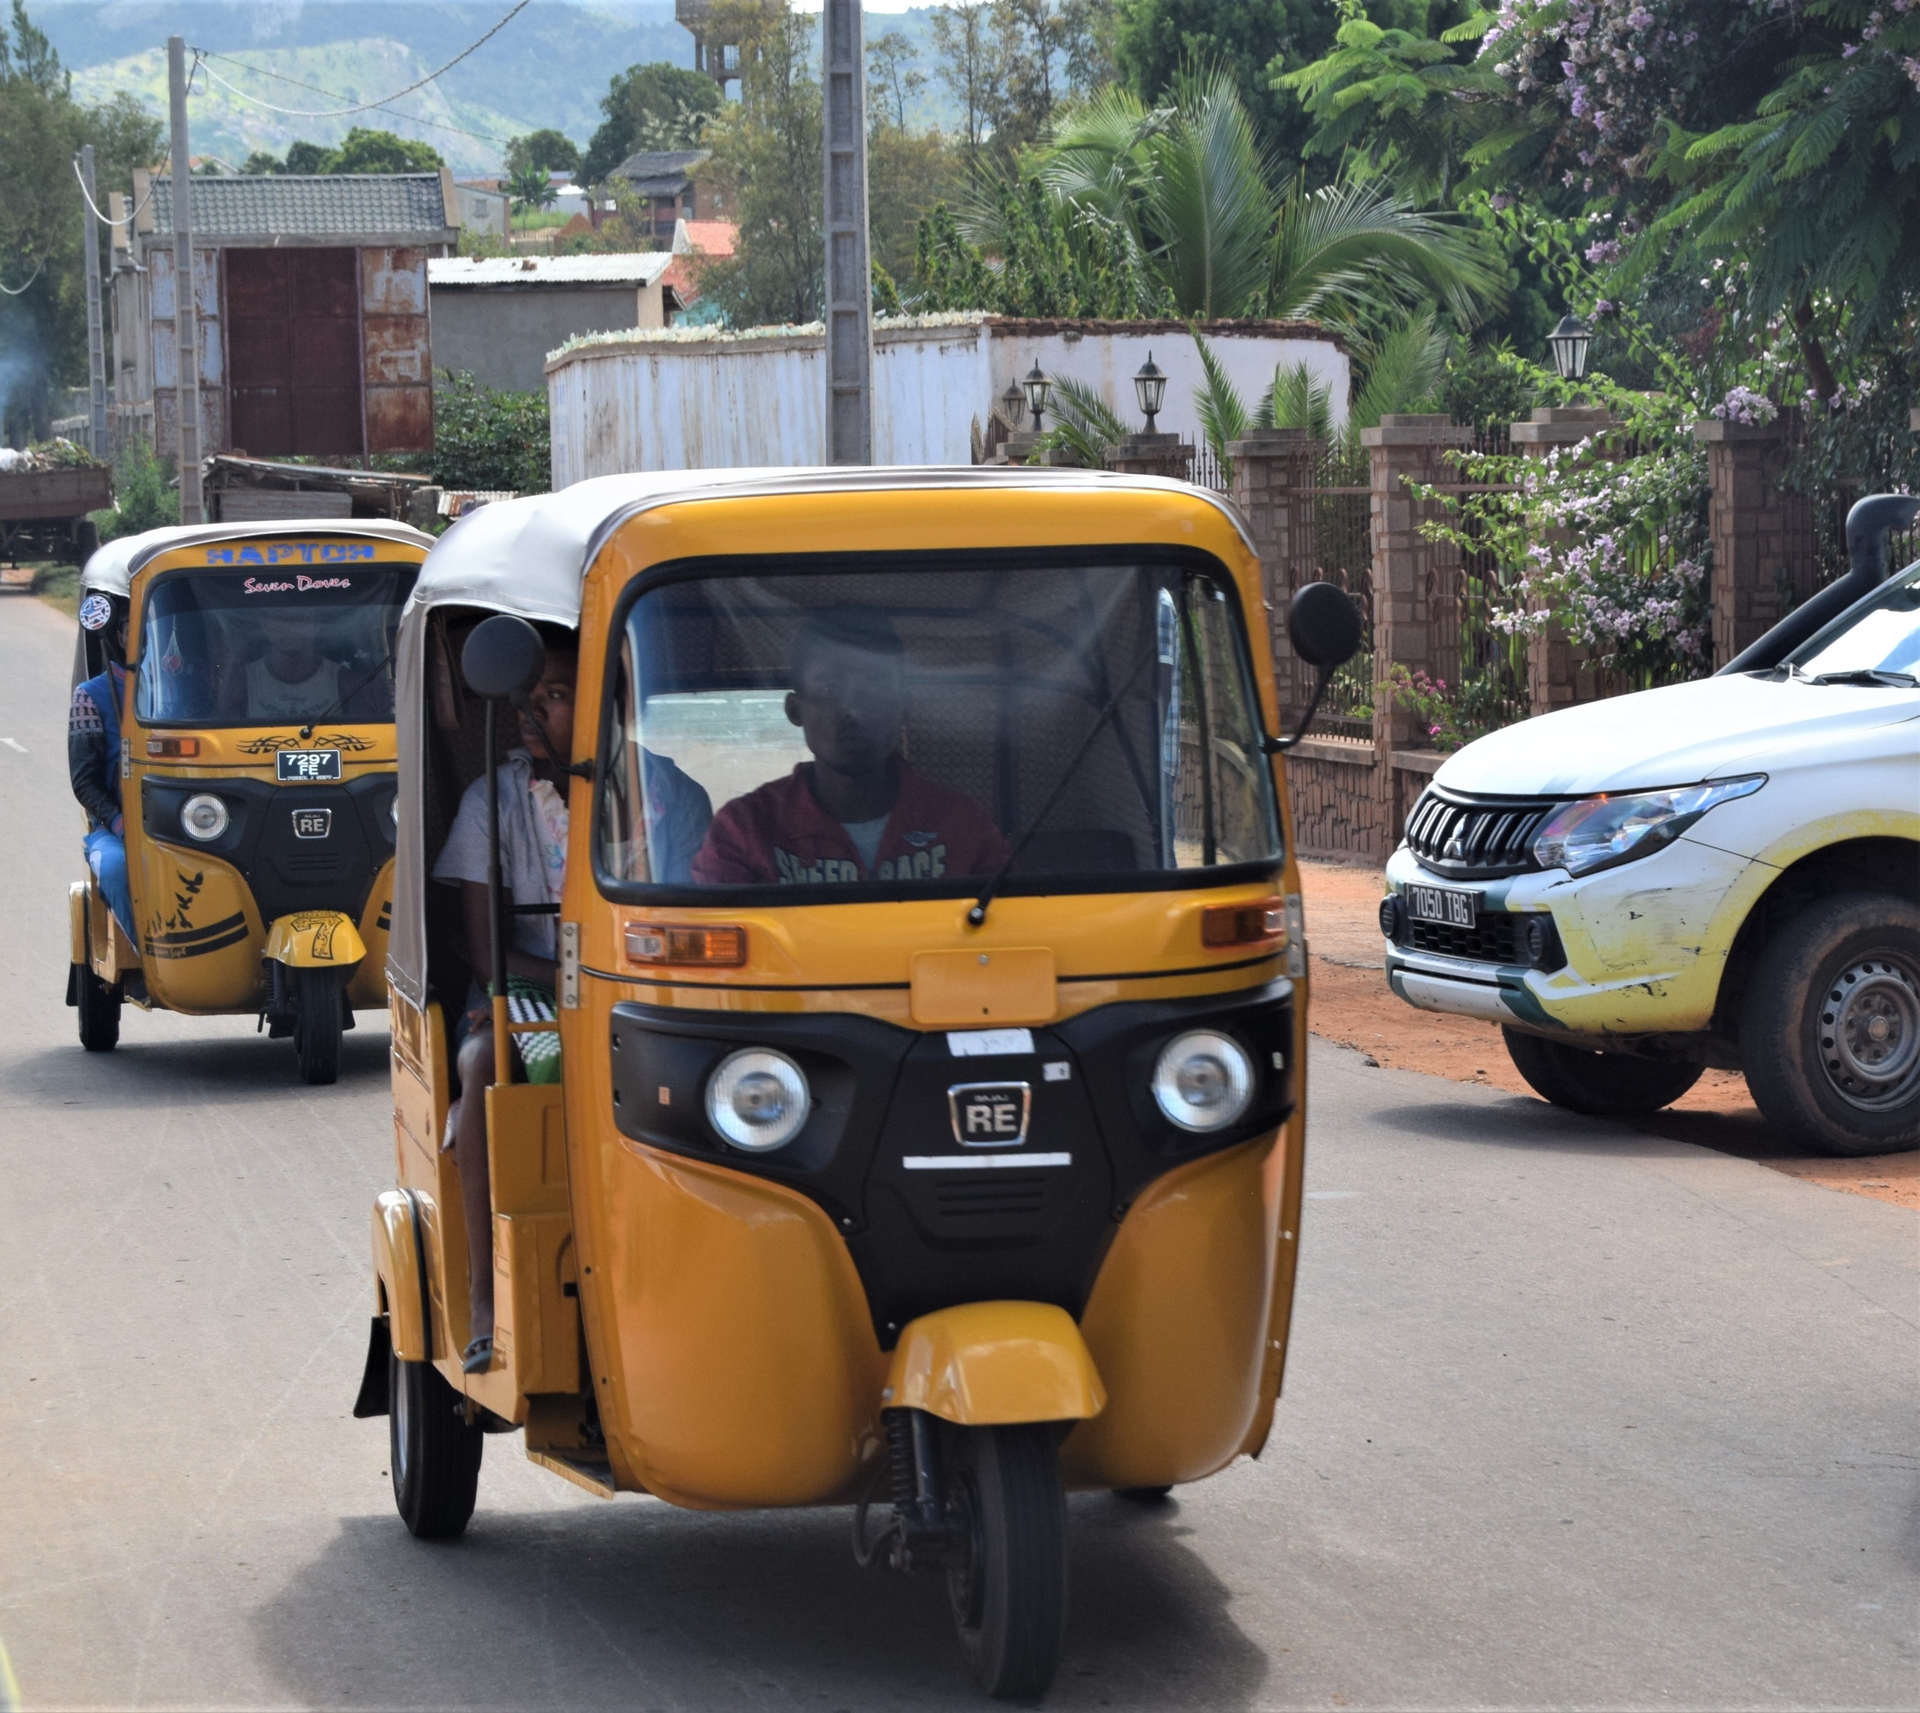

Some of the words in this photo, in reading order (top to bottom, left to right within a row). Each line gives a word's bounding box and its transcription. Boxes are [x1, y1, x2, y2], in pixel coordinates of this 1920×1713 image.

[206, 543, 375, 565] RAPTOR
[244, 577, 296, 594] Seven
[297, 575, 351, 592] Doves
[286, 754, 332, 766] 7297
[299, 765, 319, 776] FE
[300, 818, 324, 832] RE
[1412, 887, 1443, 920] 7050
[1445, 892, 1469, 924] TBG
[966, 1103, 1017, 1133] RE
